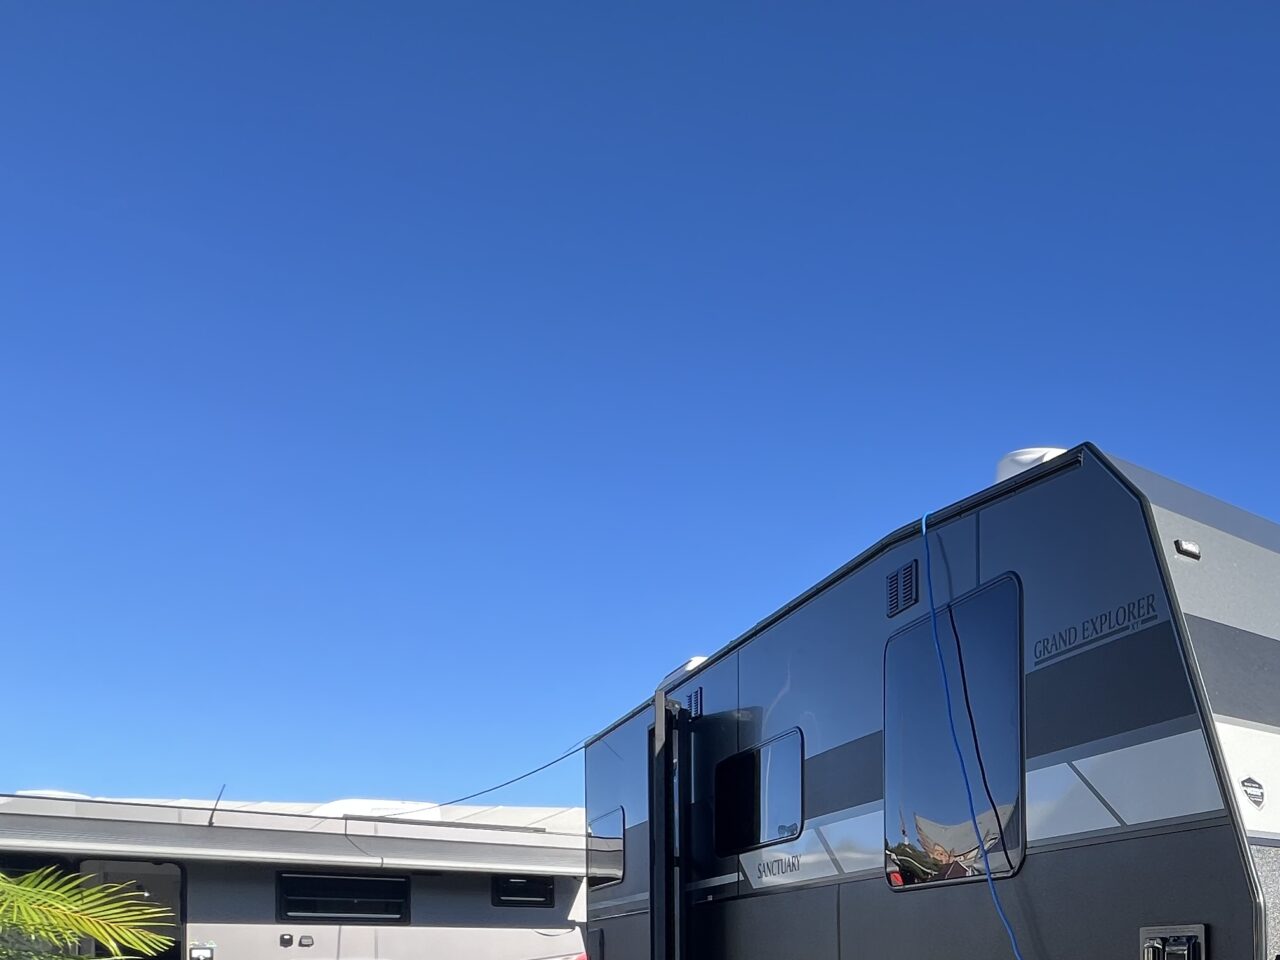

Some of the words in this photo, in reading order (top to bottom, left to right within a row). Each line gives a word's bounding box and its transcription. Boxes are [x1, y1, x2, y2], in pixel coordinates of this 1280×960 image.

[1034, 627, 1077, 659] GRAND
[1082, 594, 1156, 640] EXPLORER
[757, 854, 802, 879] SANCTUARY
